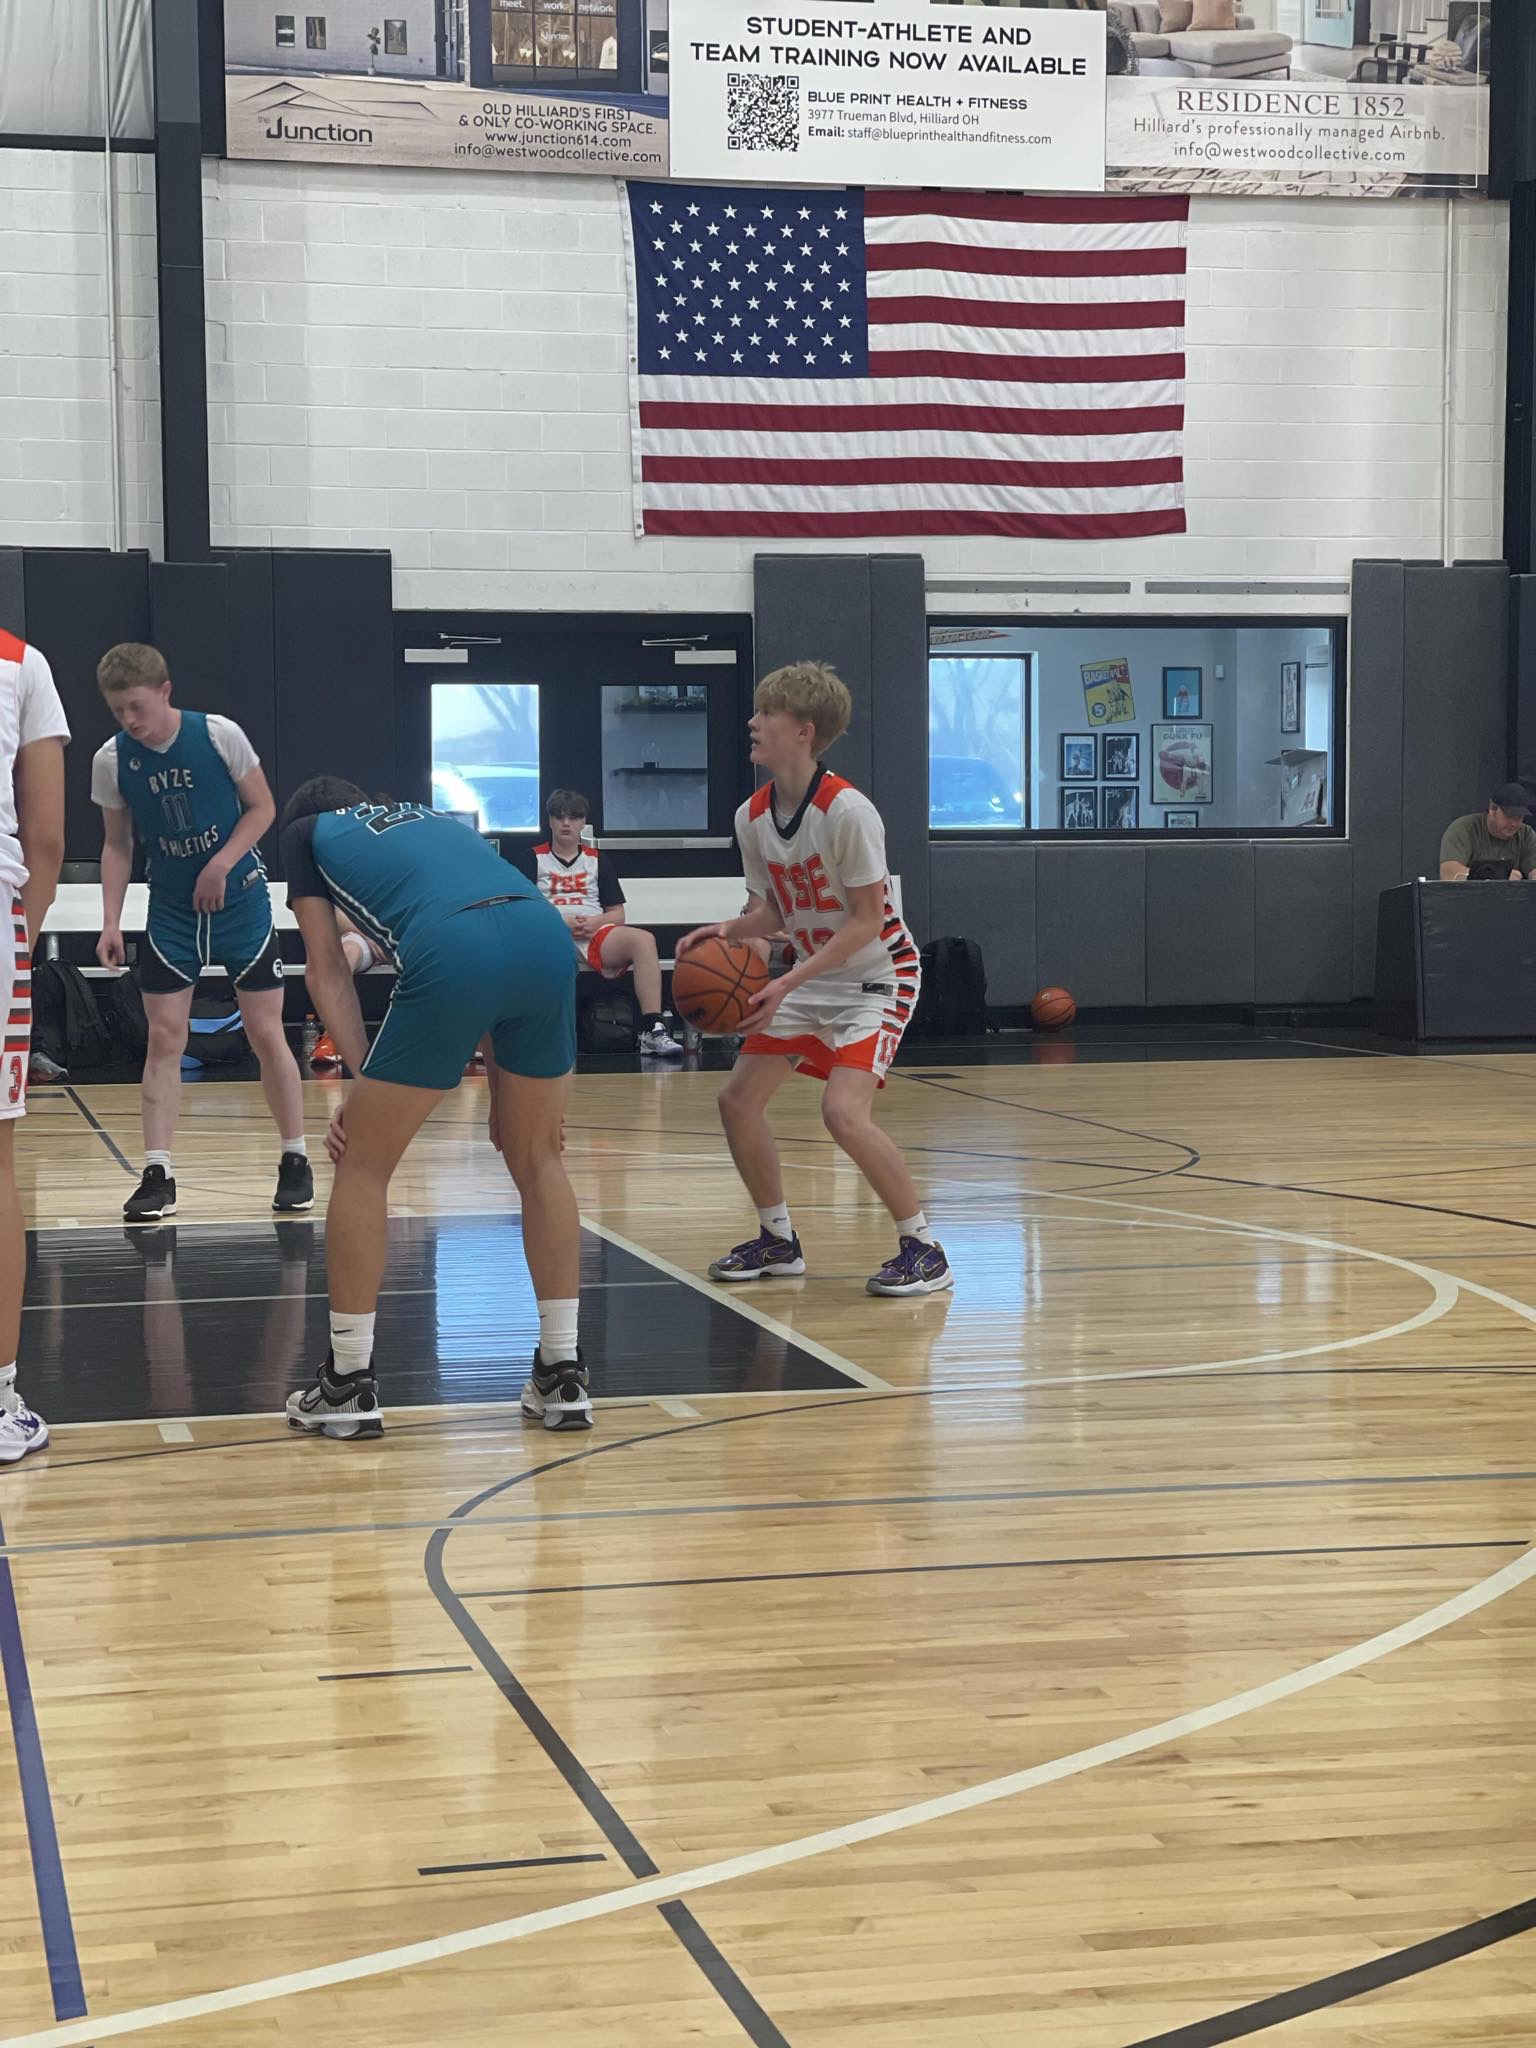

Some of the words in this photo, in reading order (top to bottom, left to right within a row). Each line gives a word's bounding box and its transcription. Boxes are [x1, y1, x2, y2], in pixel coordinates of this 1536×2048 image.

[746, 16, 973, 44] STUDENT-ATHLETE
[982, 26, 1032, 46] AND
[690, 42, 760, 64] TEAM
[770, 46, 880, 69] TRAINING
[889, 51, 947, 71] NOW
[958, 54, 1087, 76] AVAILABLE
[808, 91, 845, 105] BLUE
[850, 92, 890, 106] PRINT
[896, 94, 952, 108] HEALTH
[955, 99, 964, 108] +
[968, 97, 1028, 110] FITNESS
[1176, 90, 1340, 116] RESIDENCE
[1352, 96, 1406, 118] 1852
[482, 103, 512, 116] OLD
[516, 104, 591, 119] HILLIARD'S
[595, 108, 632, 121] FIRST
[808, 109, 834, 122] 3977
[837, 110, 887, 123] Trueman
[889, 111, 917, 125] Blvd,
[919, 112, 959, 125] Hilliard
[962, 114, 979, 126] OH
[266, 116, 373, 142] Junction
[458, 115, 469, 127] &
[473, 116, 511, 129] ONLY
[514, 117, 608, 133] CO-WORKING
[611, 121, 657, 135] SPACE.
[808, 126, 845, 139] Email:
[847, 127, 1052, 145] staff@blueprinthealthandfitness.com
[1134, 117, 1202, 135] Hilliard's
[1207, 120, 1313, 143] professionally
[1318, 128, 1384, 144] managed
[1390, 125, 1446, 141] Airbnb.
[485, 131, 632, 148] www.junction614.com
[454, 143, 662, 164] info@westwoodcollective.com
[1173, 143, 1406, 162] info@westwoodcollective.com
[550, 871, 588, 896] TSE
[767, 853, 844, 918] TSE
